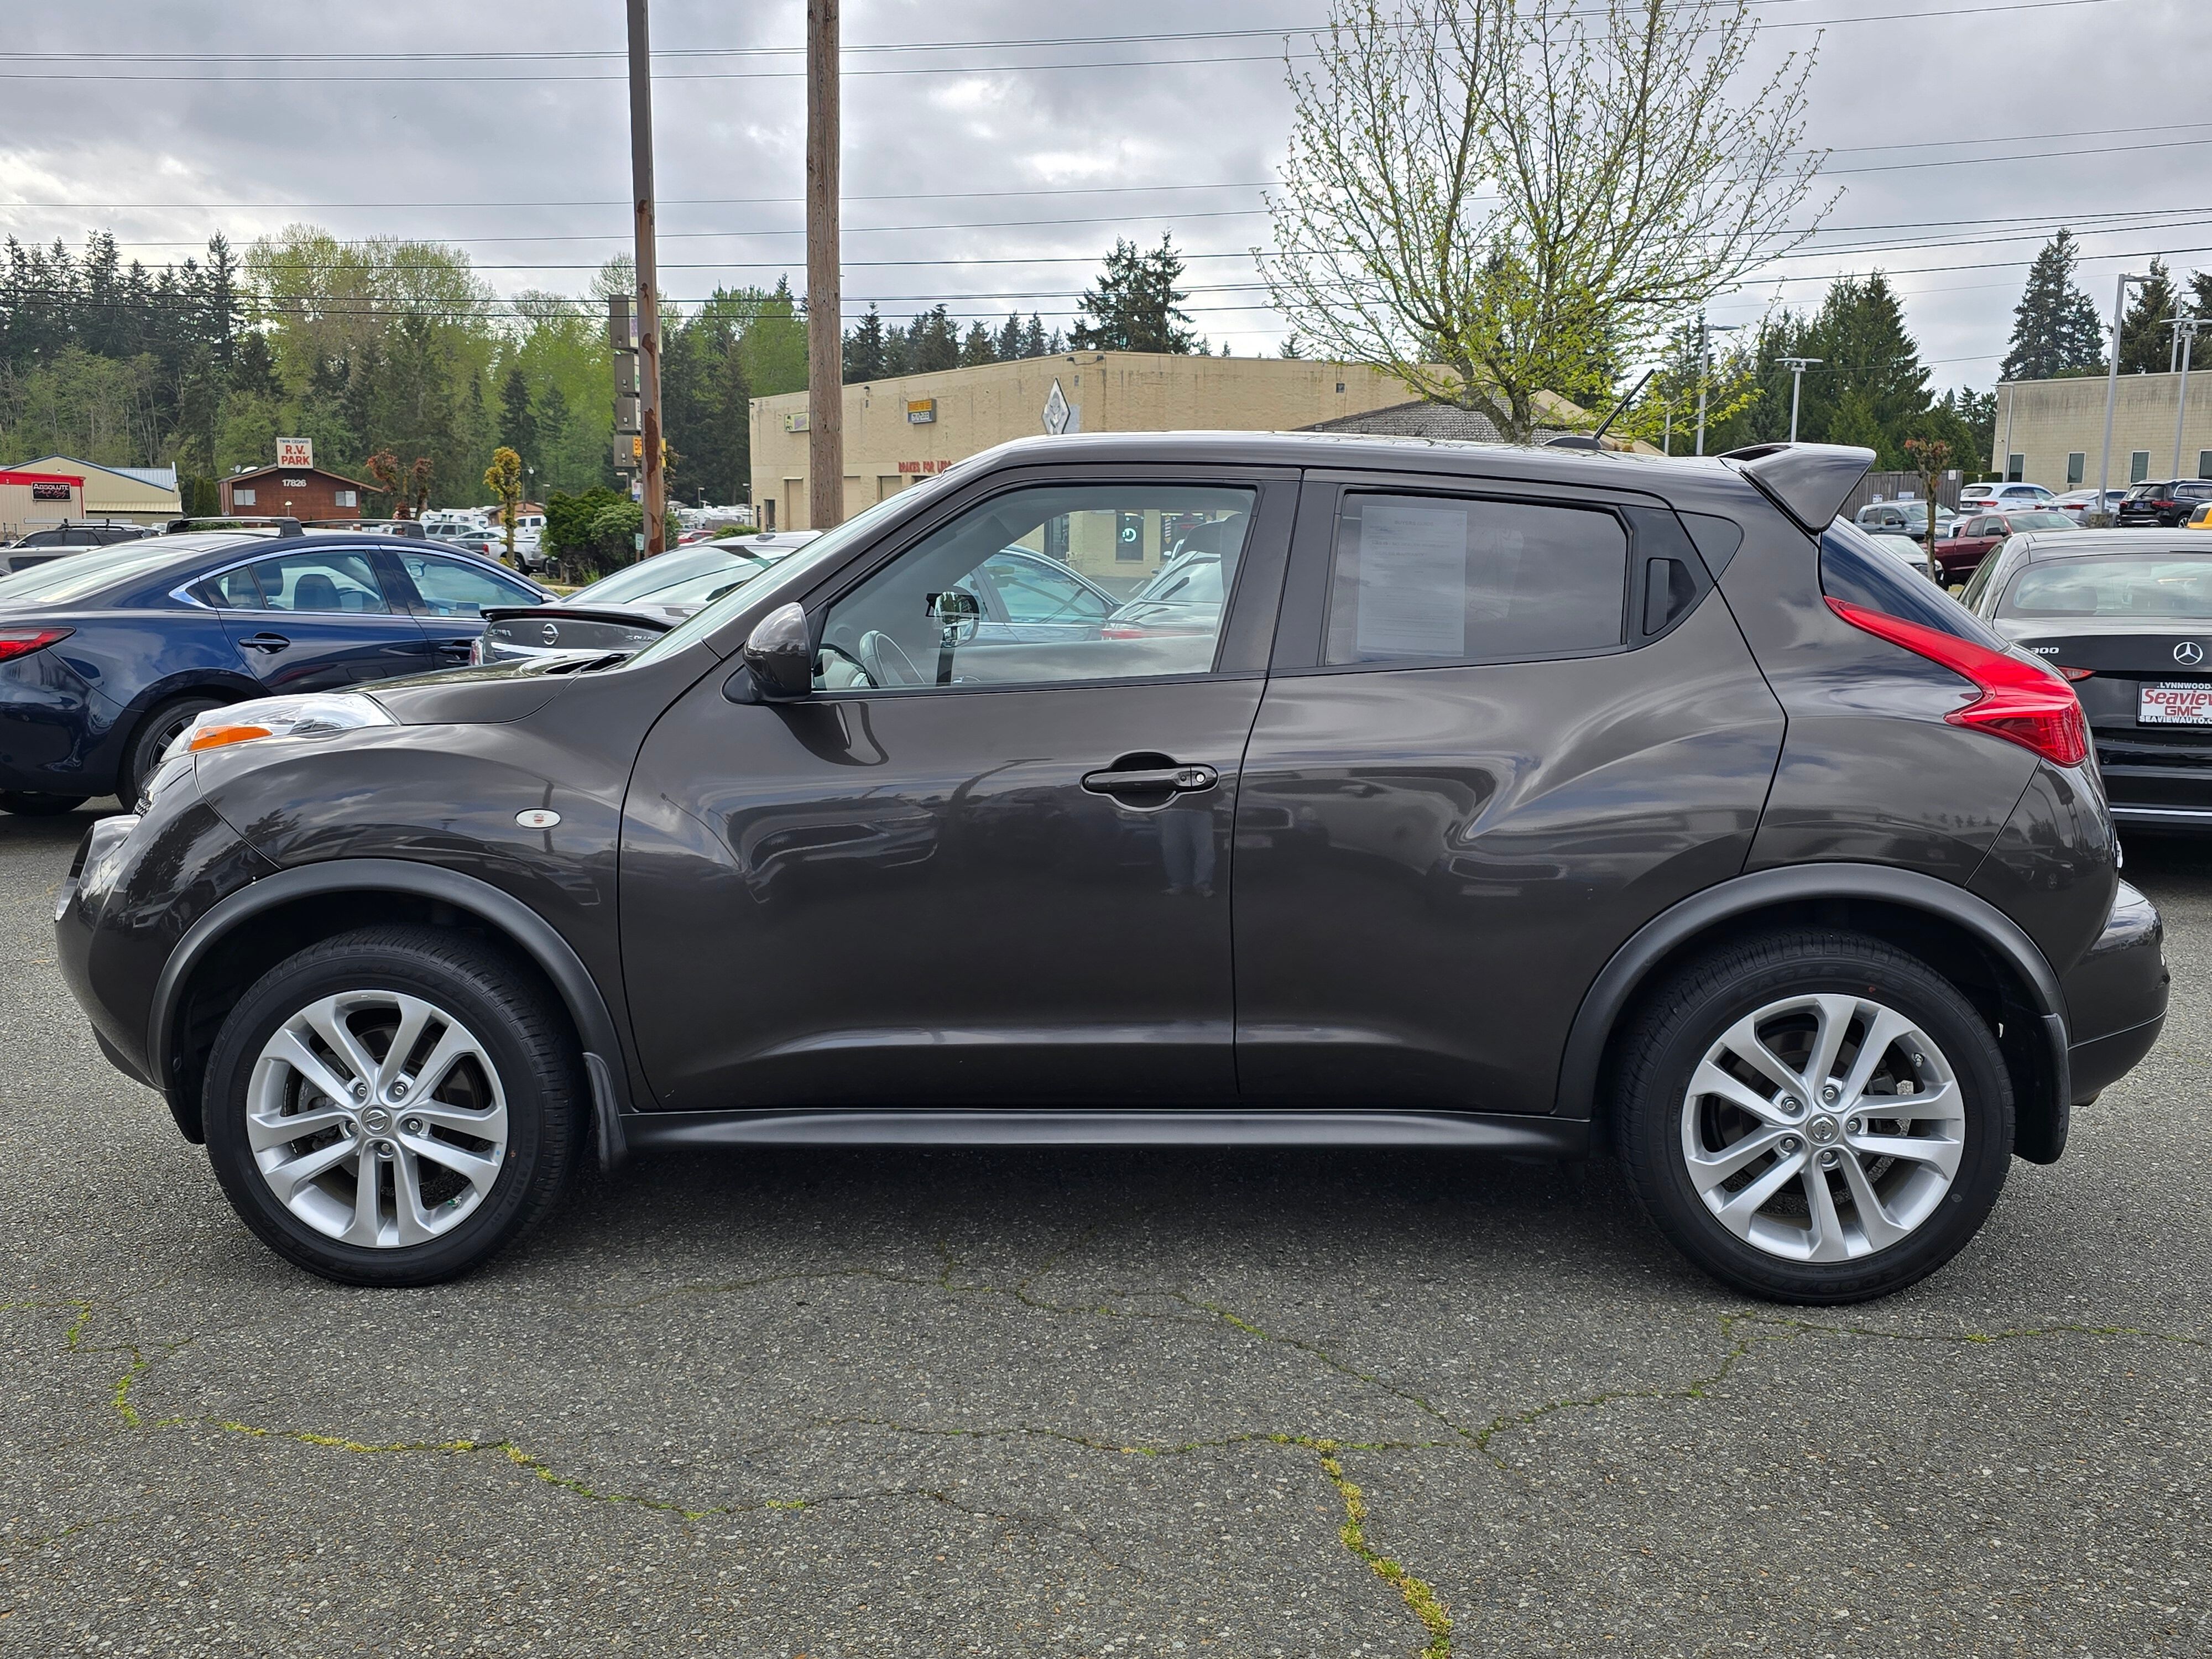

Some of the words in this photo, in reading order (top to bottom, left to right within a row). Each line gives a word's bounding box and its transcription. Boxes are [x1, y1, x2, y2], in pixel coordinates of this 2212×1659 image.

[285, 445, 305, 455] R.V.
[281, 456, 310, 465] PARK
[2164, 706, 2203, 717] GMC
